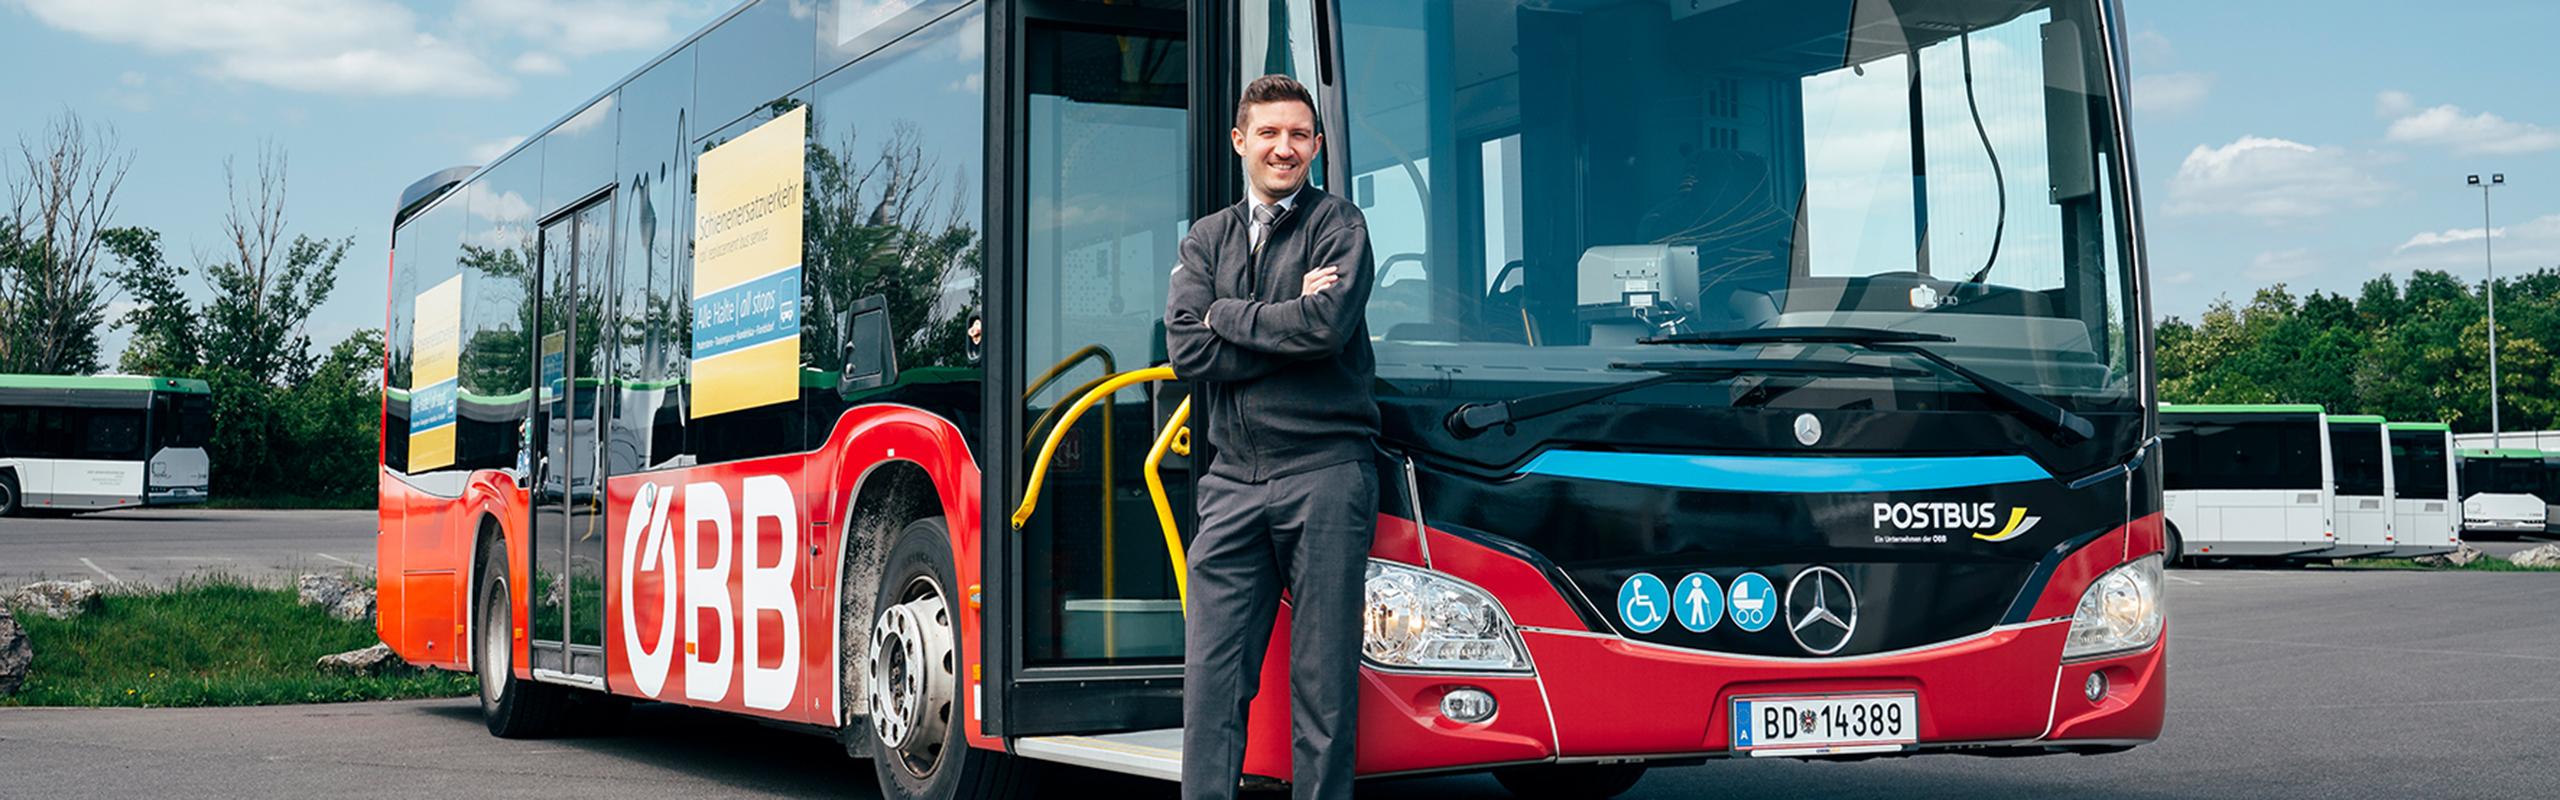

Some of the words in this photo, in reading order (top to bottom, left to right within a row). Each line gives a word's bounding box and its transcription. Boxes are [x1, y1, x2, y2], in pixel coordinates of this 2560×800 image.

[699, 178, 798, 240] Schienenersatzverkehr
[696, 303, 712, 330] Alle
[712, 297, 735, 325] Halte
[740, 290, 752, 318] all
[752, 289, 776, 318] stops
[1873, 502, 1996, 529] POSTBUS
[1922, 535, 1931, 543] der
[621, 474, 800, 711] ÖBB
[1740, 729, 1749, 740] A
[1764, 706, 1797, 739] BD
[1821, 703, 1902, 738] 14389
